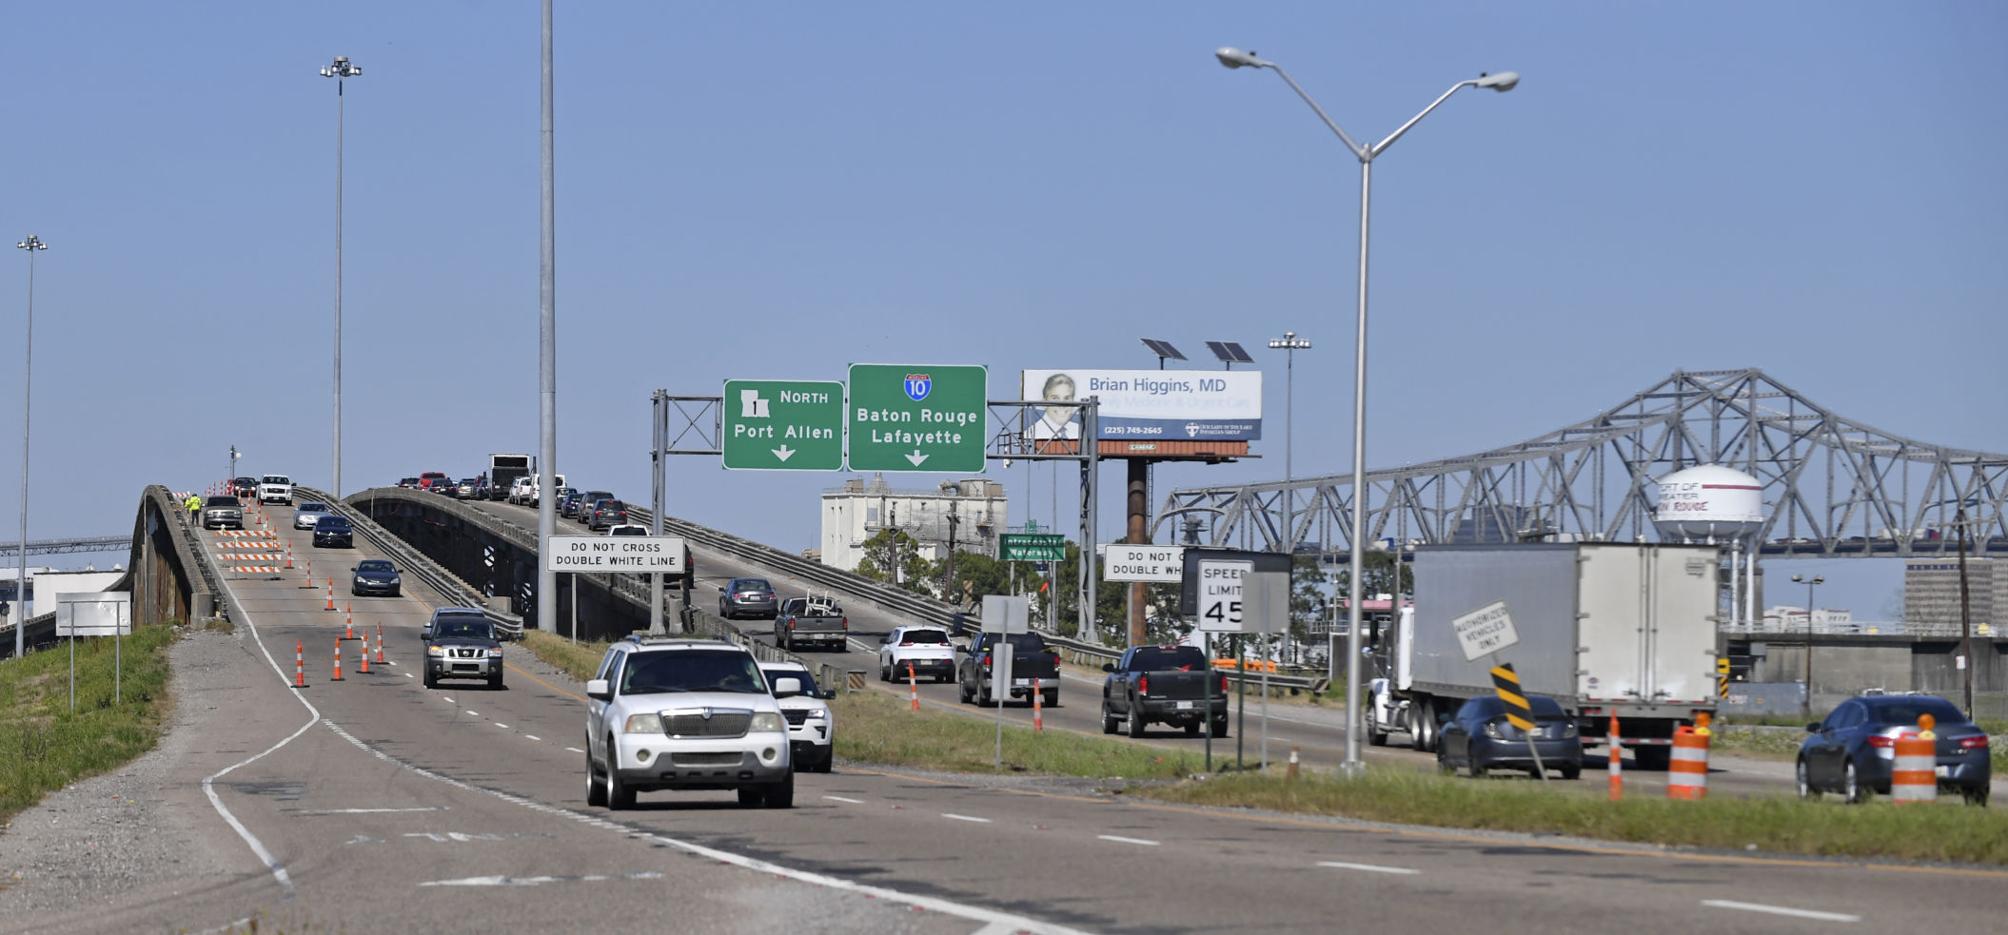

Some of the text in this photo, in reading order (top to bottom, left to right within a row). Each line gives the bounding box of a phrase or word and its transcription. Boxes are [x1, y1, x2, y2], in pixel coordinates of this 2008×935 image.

[910, 380, 926, 396] 10
[1089, 377, 1226, 395] Brian Higgins, MD
[780, 390, 828, 404] NORTH
[752, 400, 758, 415] 1
[857, 408, 977, 427] Baton Rouge
[734, 424, 833, 439] Port Allen
[872, 429, 962, 446] Lafayette
[1104, 426, 1124, 435] (225)
[571, 543, 661, 553] DO NOT CROSS
[556, 556, 676, 566] DOUBLE WHITE LINE
[1128, 552, 1143, 561] DO
[1149, 552, 1172, 561] NOT
[1113, 565, 1158, 574] DOUBLE
[1208, 585, 1243, 596] LIMIT
[1205, 601, 1242, 623] 45
